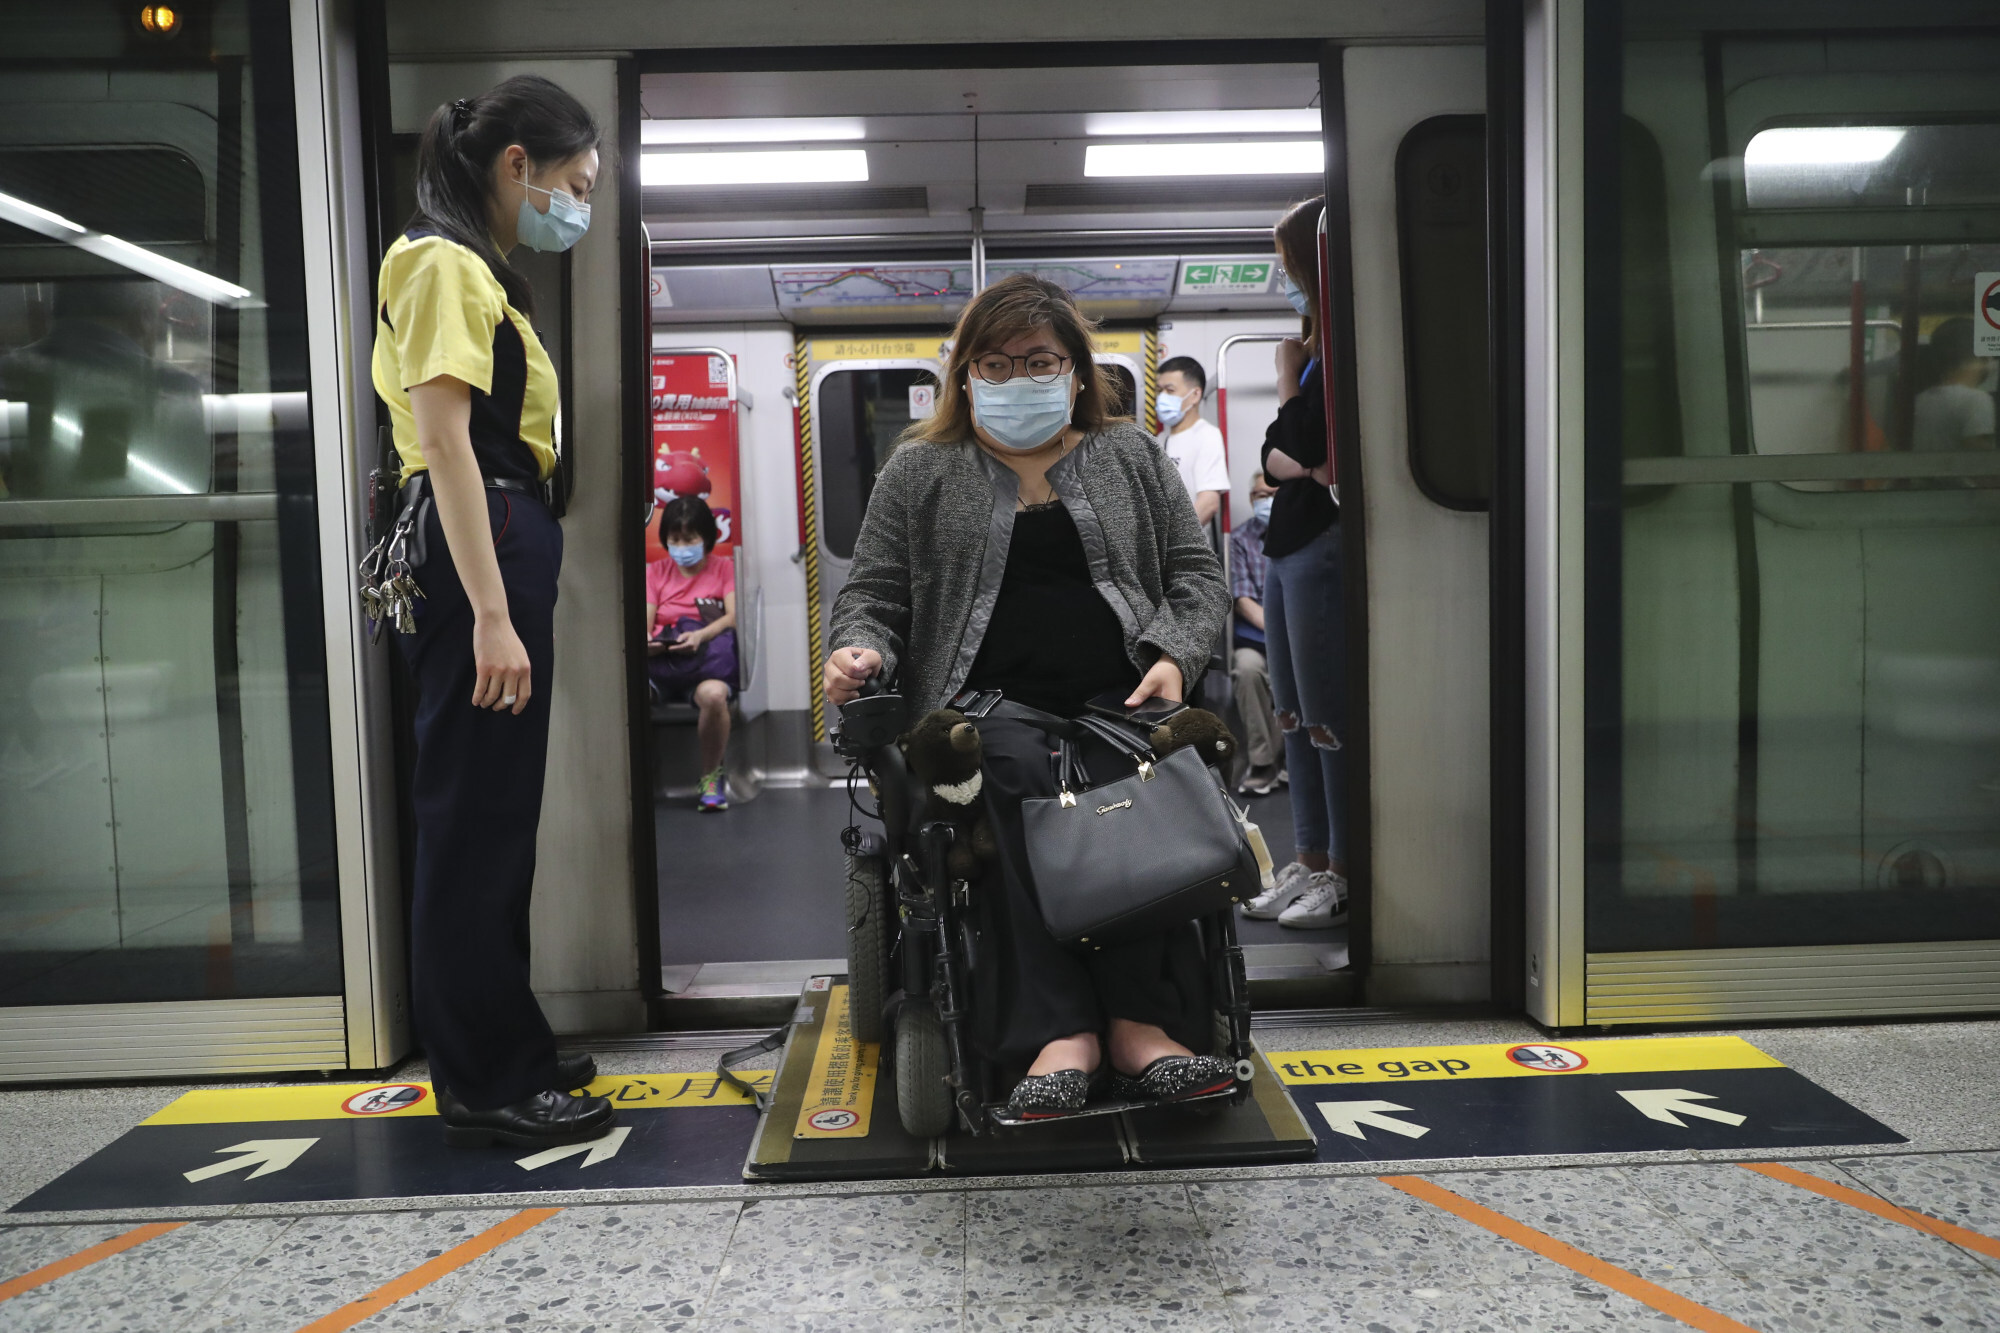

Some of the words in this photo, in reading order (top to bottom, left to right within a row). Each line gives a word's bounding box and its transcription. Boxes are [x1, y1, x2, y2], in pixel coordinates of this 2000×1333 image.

[1281, 1060, 1363, 1077] the
[1377, 1057, 1471, 1078] gap
[846, 1092, 857, 1105] Thank
